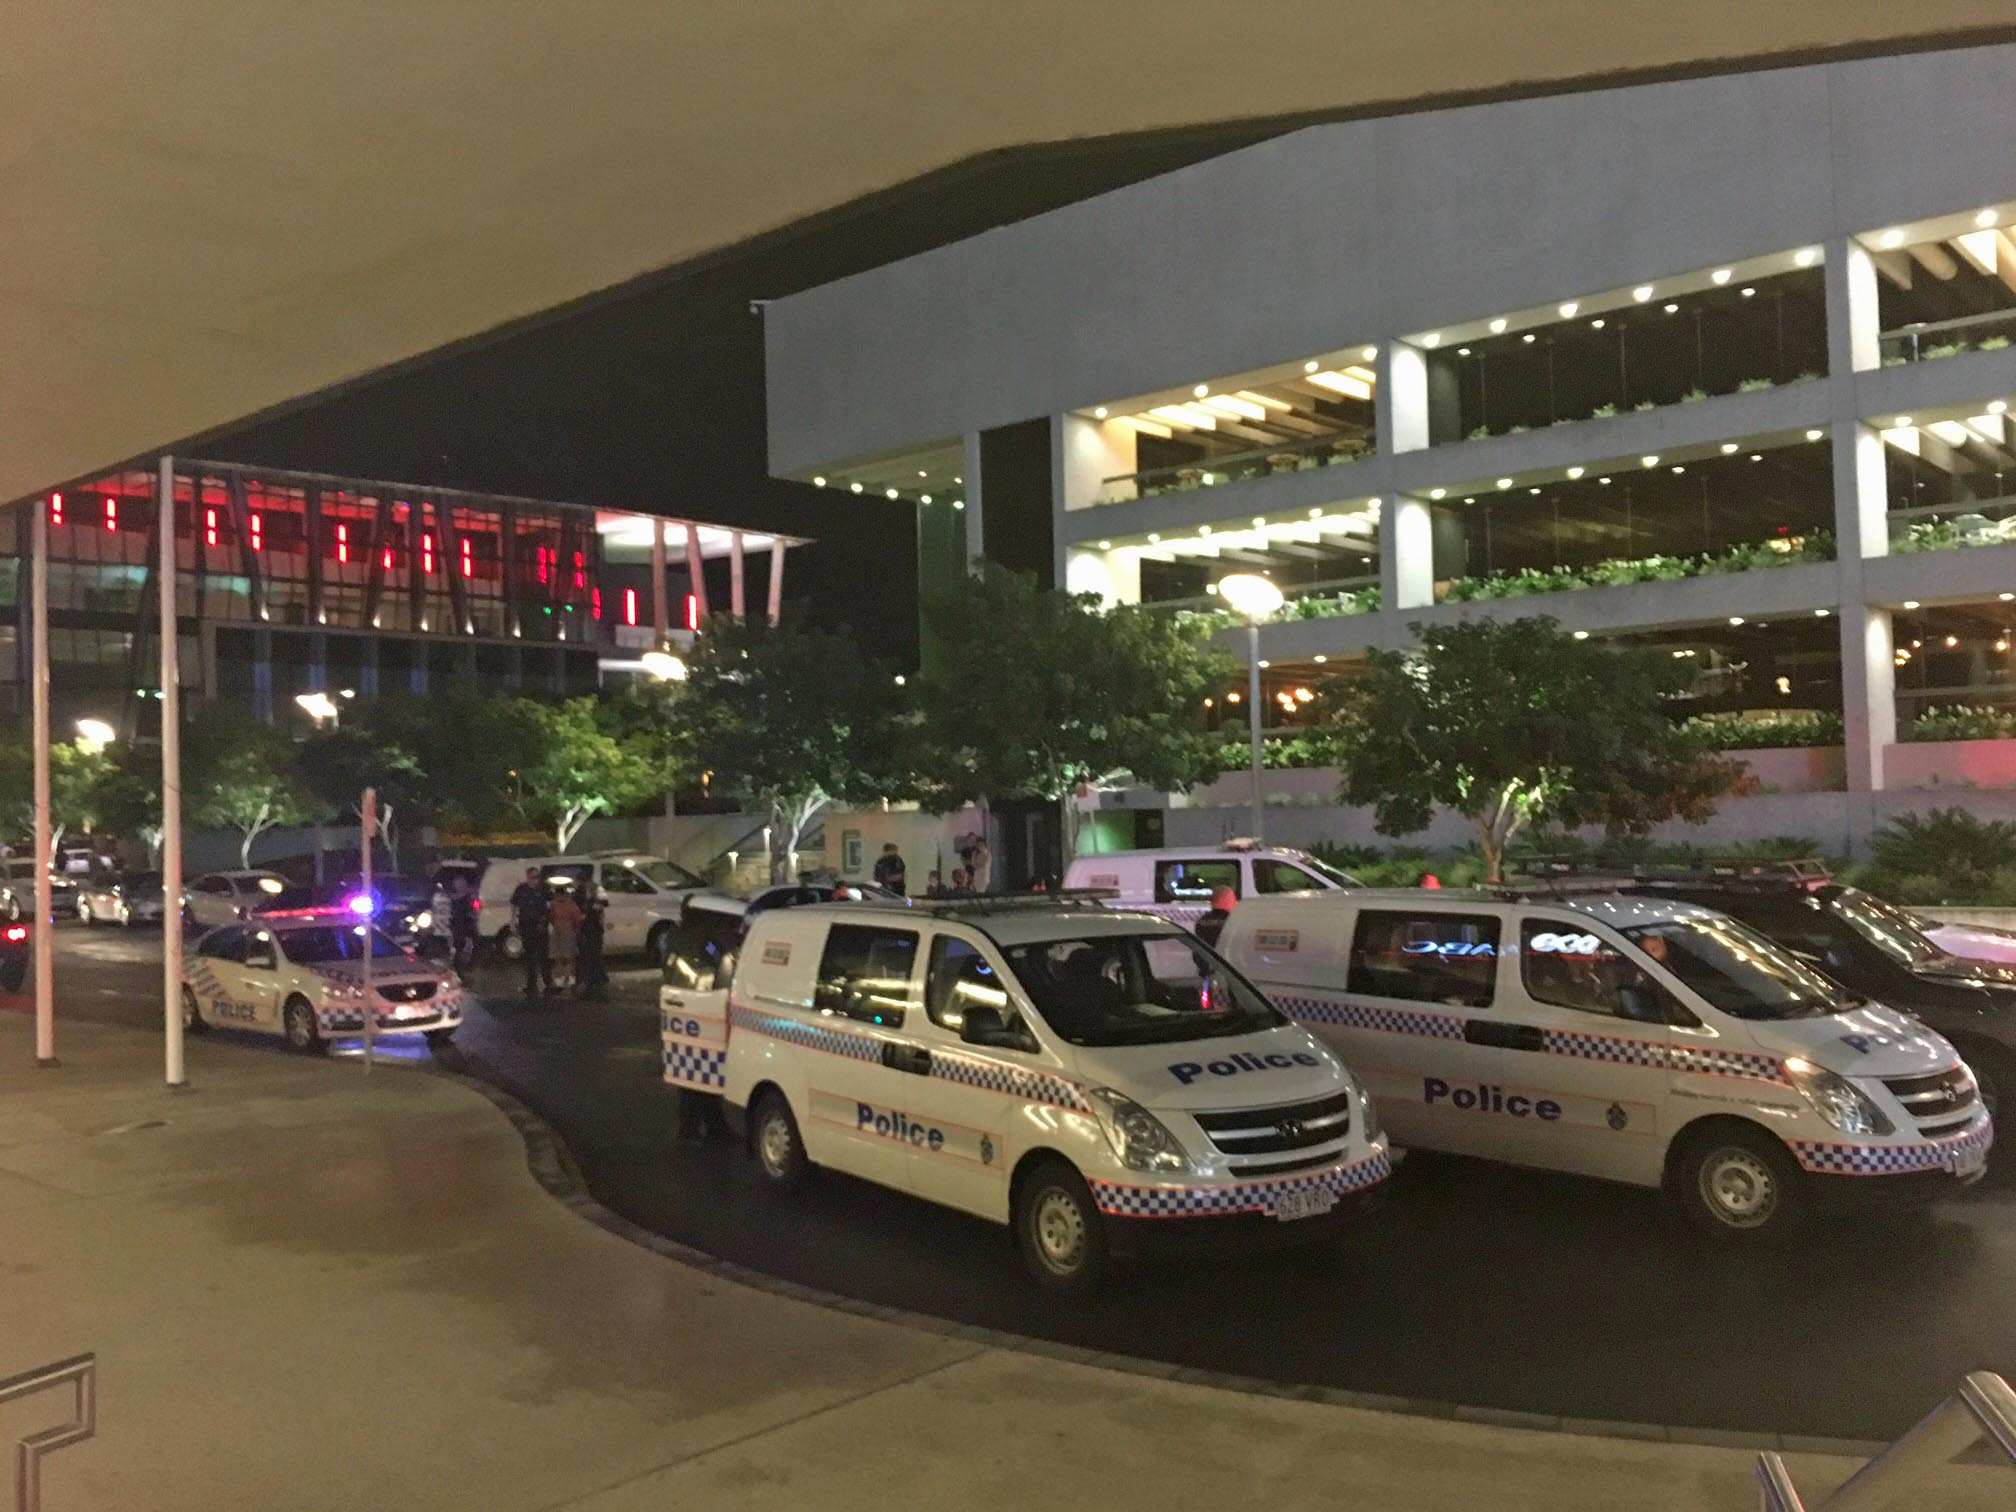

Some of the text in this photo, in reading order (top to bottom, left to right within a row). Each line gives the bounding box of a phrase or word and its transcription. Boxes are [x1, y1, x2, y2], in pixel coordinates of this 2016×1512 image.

[212, 1000, 257, 1022] POLICE
[1168, 1052, 1320, 1085] Police
[1424, 1077, 1562, 1121] Police
[857, 1101, 944, 1152] Police
